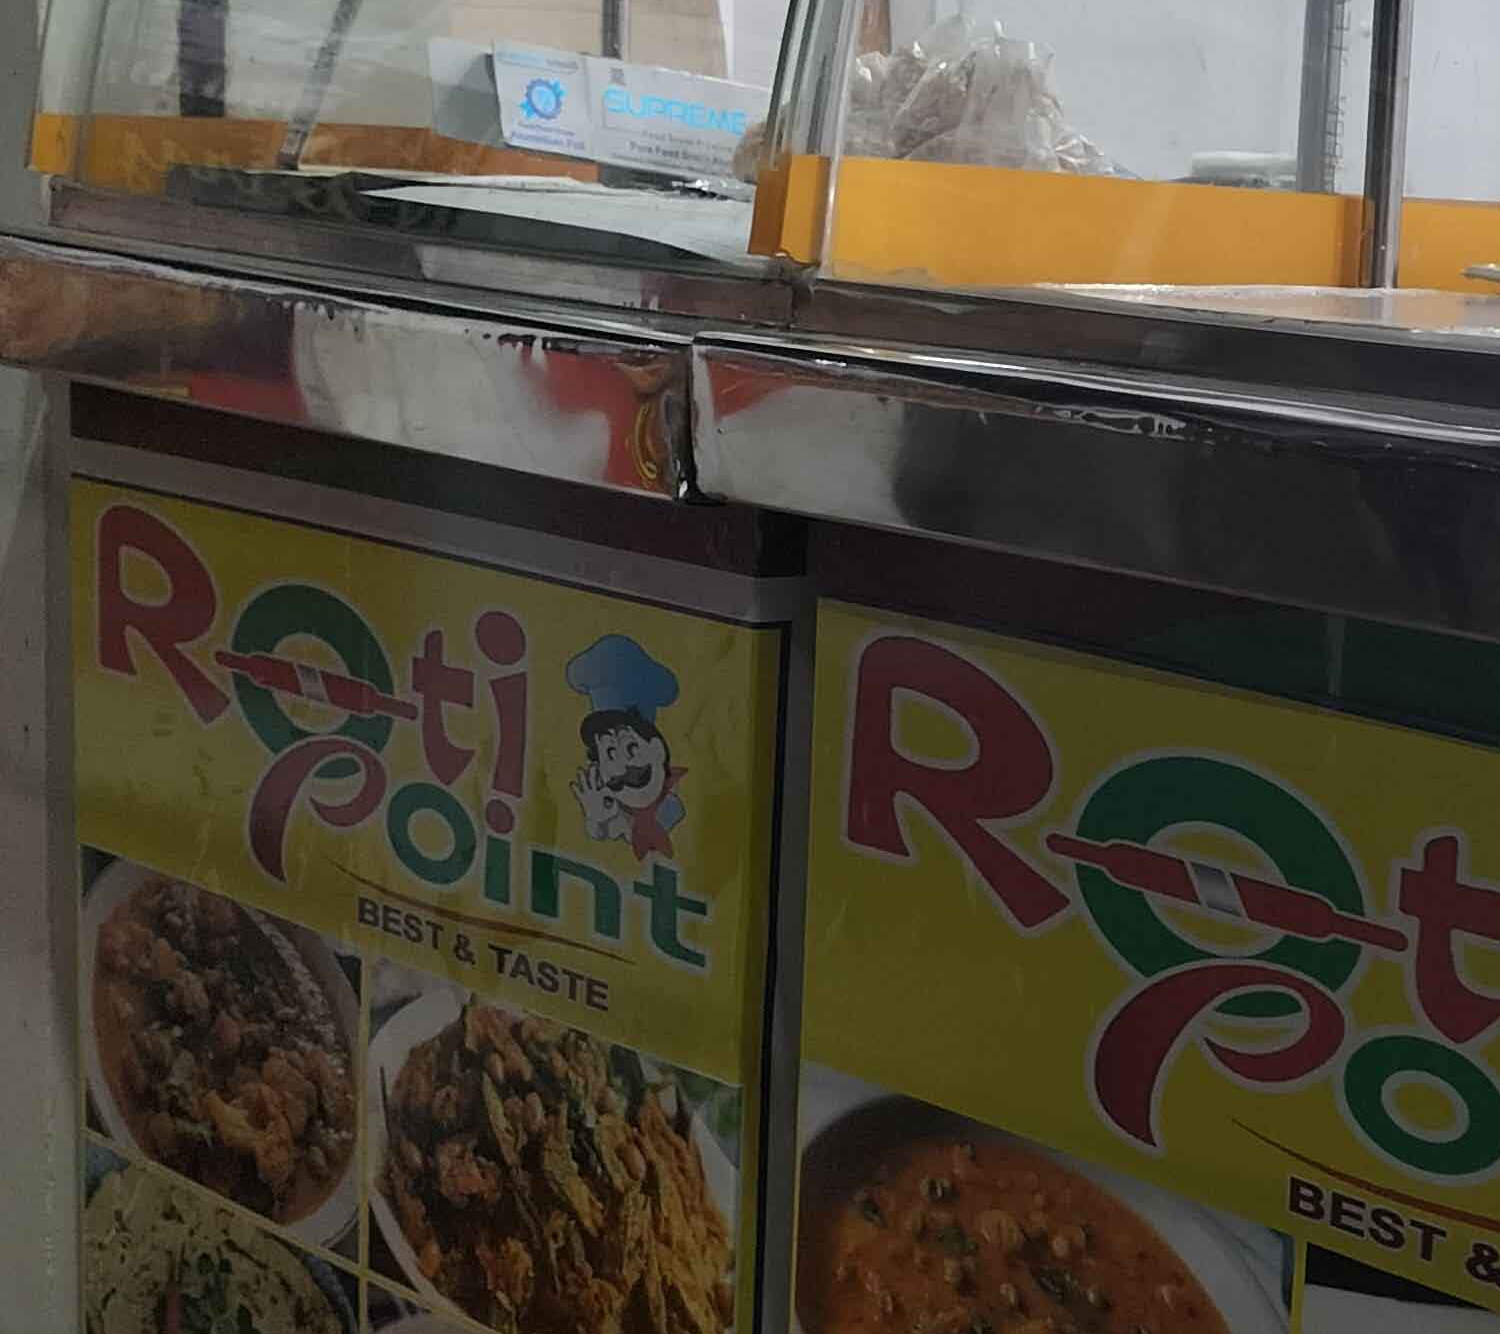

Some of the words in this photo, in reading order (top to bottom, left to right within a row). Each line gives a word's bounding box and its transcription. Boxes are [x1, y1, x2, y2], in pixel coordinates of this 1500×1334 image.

[603, 83, 747, 138] SUPREME
[98, 503, 528, 800] Roti
[247, 737, 708, 968] Point
[357, 896, 443, 952] BEST
[452, 933, 477, 967] &
[489, 943, 610, 1013] TASTE
[1287, 1175, 1447, 1265] BEST
